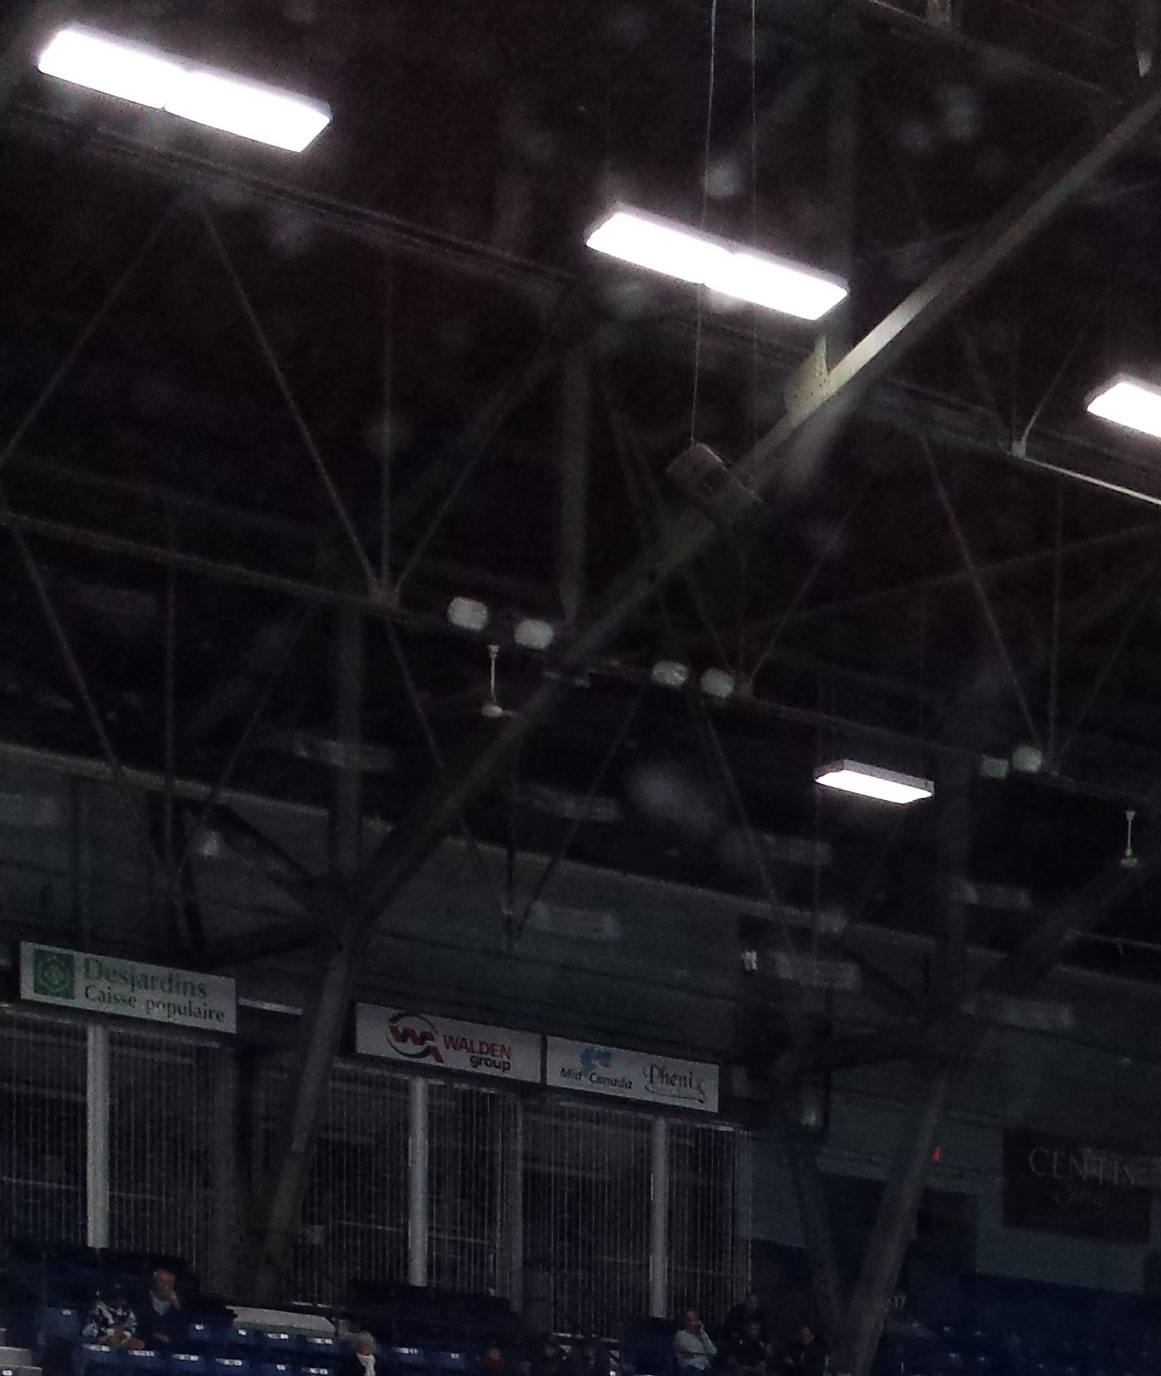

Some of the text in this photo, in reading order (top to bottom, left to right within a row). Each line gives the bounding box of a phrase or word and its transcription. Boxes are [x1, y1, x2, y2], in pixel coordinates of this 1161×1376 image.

[84, 957, 207, 998] Desjardins
[85, 985, 226, 1024] Caisse populaire
[443, 1035, 511, 1060] WALDEN
[470, 1055, 511, 1073] group
